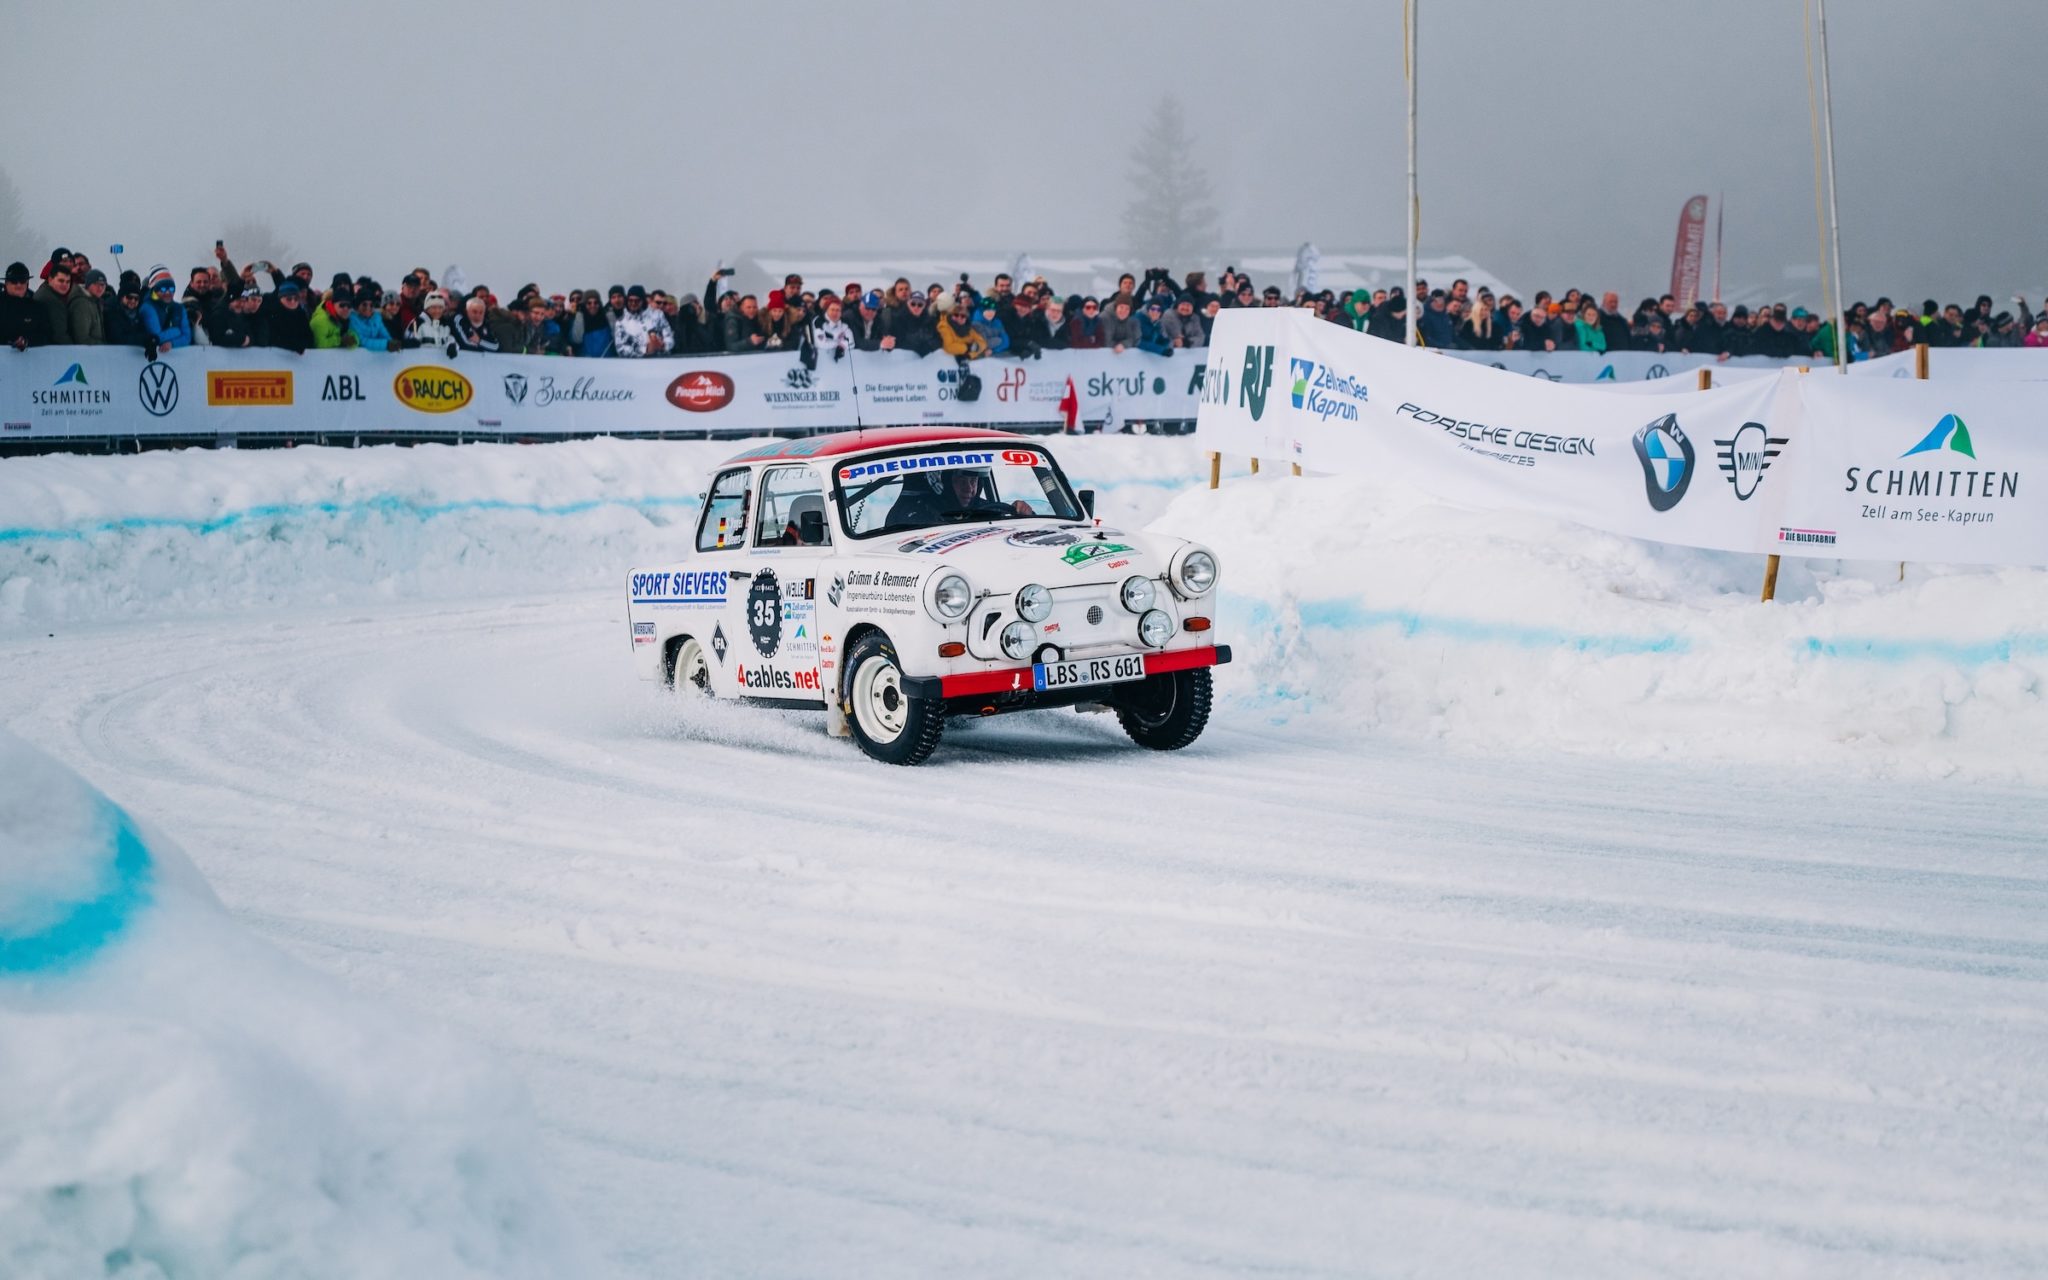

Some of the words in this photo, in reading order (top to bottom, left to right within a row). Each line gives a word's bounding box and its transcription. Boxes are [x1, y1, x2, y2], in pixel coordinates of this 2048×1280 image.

[215, 377, 287, 399] PIRELLI
[321, 375, 366, 401] ABL
[412, 378, 464, 401] RAUCH
[535, 376, 636, 407] Backhausen
[865, 384, 876, 392] Die
[878, 383, 904, 394] Energie
[906, 383, 915, 391] für
[917, 383, 928, 391] ein
[1087, 371, 1146, 397] skruf
[1240, 345, 1275, 422] RUF
[32, 390, 111, 404] SCHMITTEN
[764, 391, 817, 403] WIENINGER
[819, 391, 840, 402] BIER
[873, 395, 903, 403] besseres
[1307, 389, 1358, 422] Kaprun
[41, 408, 54, 416] Zell
[1396, 402, 1512, 446] PORSCHE
[1514, 430, 1595, 457] DESIGN
[848, 453, 994, 480] PNEUMANT
[1738, 451, 1763, 471] MINI
[1845, 467, 2019, 498] SCHMITTEN
[1862, 505, 1886, 519] Zell
[1890, 509, 1912, 521] am
[1785, 532, 1796, 542] DIE
[1796, 533, 1837, 545] BILDFABRIK
[632, 573, 670, 597] SPORT
[672, 571, 728, 596] SIEVERS
[847, 570, 873, 586] Grimm
[873, 572, 880, 586] &
[881, 572, 920, 588] Remmert
[846, 591, 883, 602] Ingenieurbüro
[884, 592, 916, 603] Lobenstein
[753, 599, 775, 627] 35
[714, 636, 726, 651] IFA
[737, 663, 821, 691] 4cables.net
[1046, 662, 1078, 686] LBS
[1090, 660, 1111, 681] RS
[1115, 655, 1143, 678] 601
